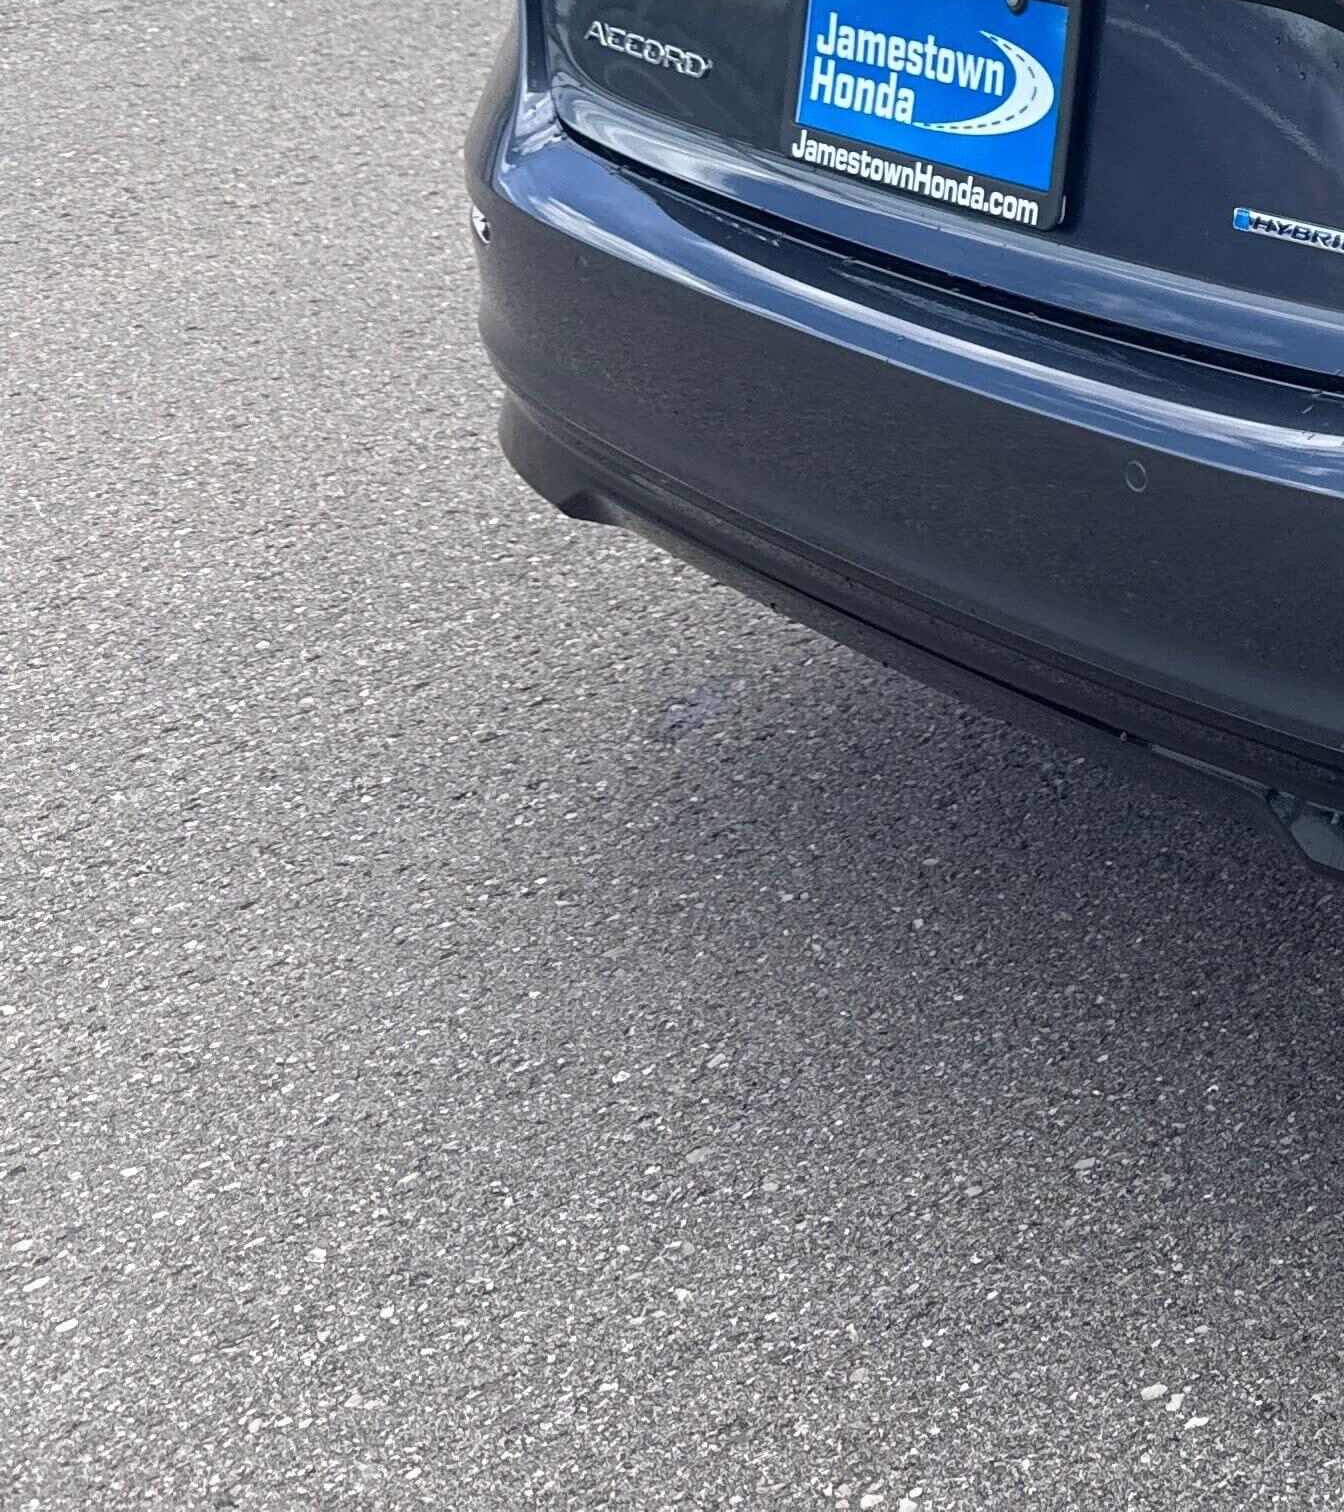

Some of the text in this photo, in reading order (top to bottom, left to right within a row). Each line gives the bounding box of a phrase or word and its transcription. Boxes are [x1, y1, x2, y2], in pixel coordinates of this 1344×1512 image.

[583, 20, 713, 78] ACCORD
[816, 12, 1005, 96] Jamestown
[810, 56, 915, 125] Honda
[792, 129, 1038, 226] JamestownHonda.com
